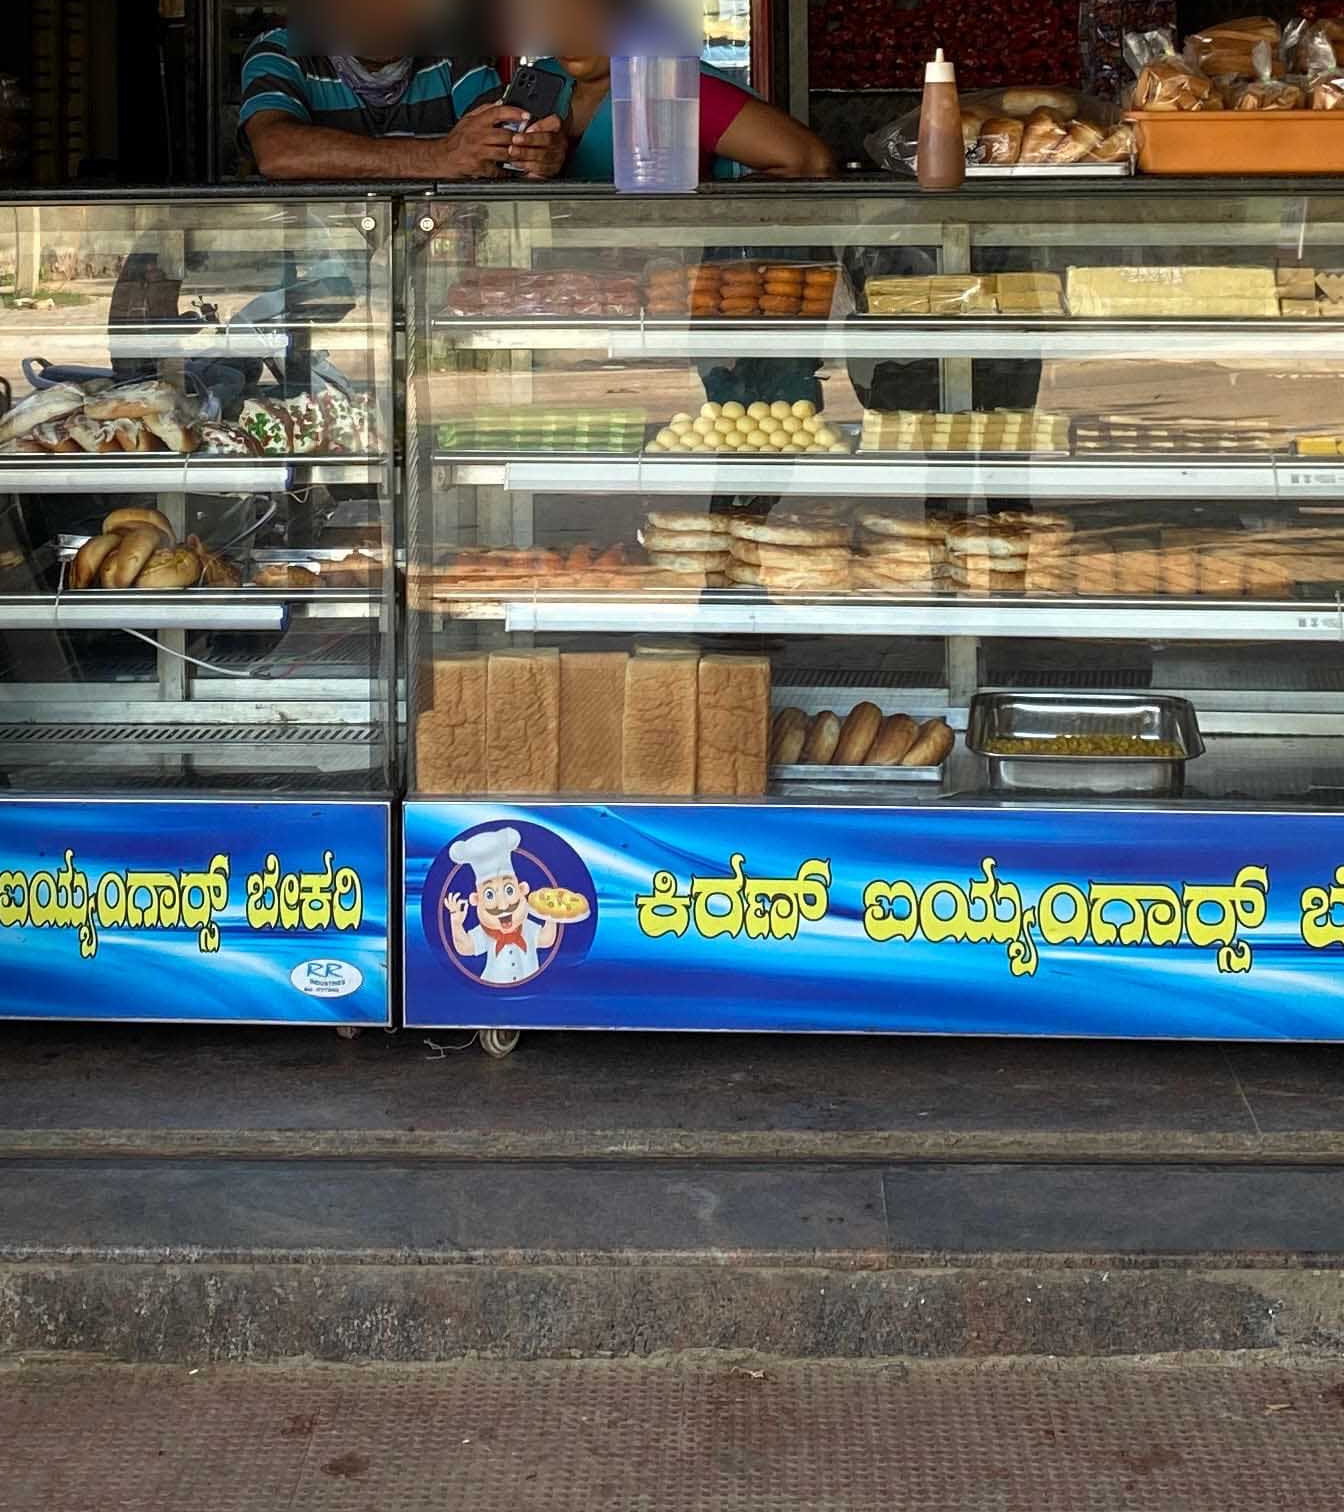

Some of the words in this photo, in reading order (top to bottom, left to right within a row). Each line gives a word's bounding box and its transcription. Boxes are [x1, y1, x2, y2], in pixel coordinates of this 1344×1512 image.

[246, 850, 363, 930] ಬೇಕರಿ
[636, 854, 831, 941] ಕಿರಣ್
[307, 962, 344, 978] RR
